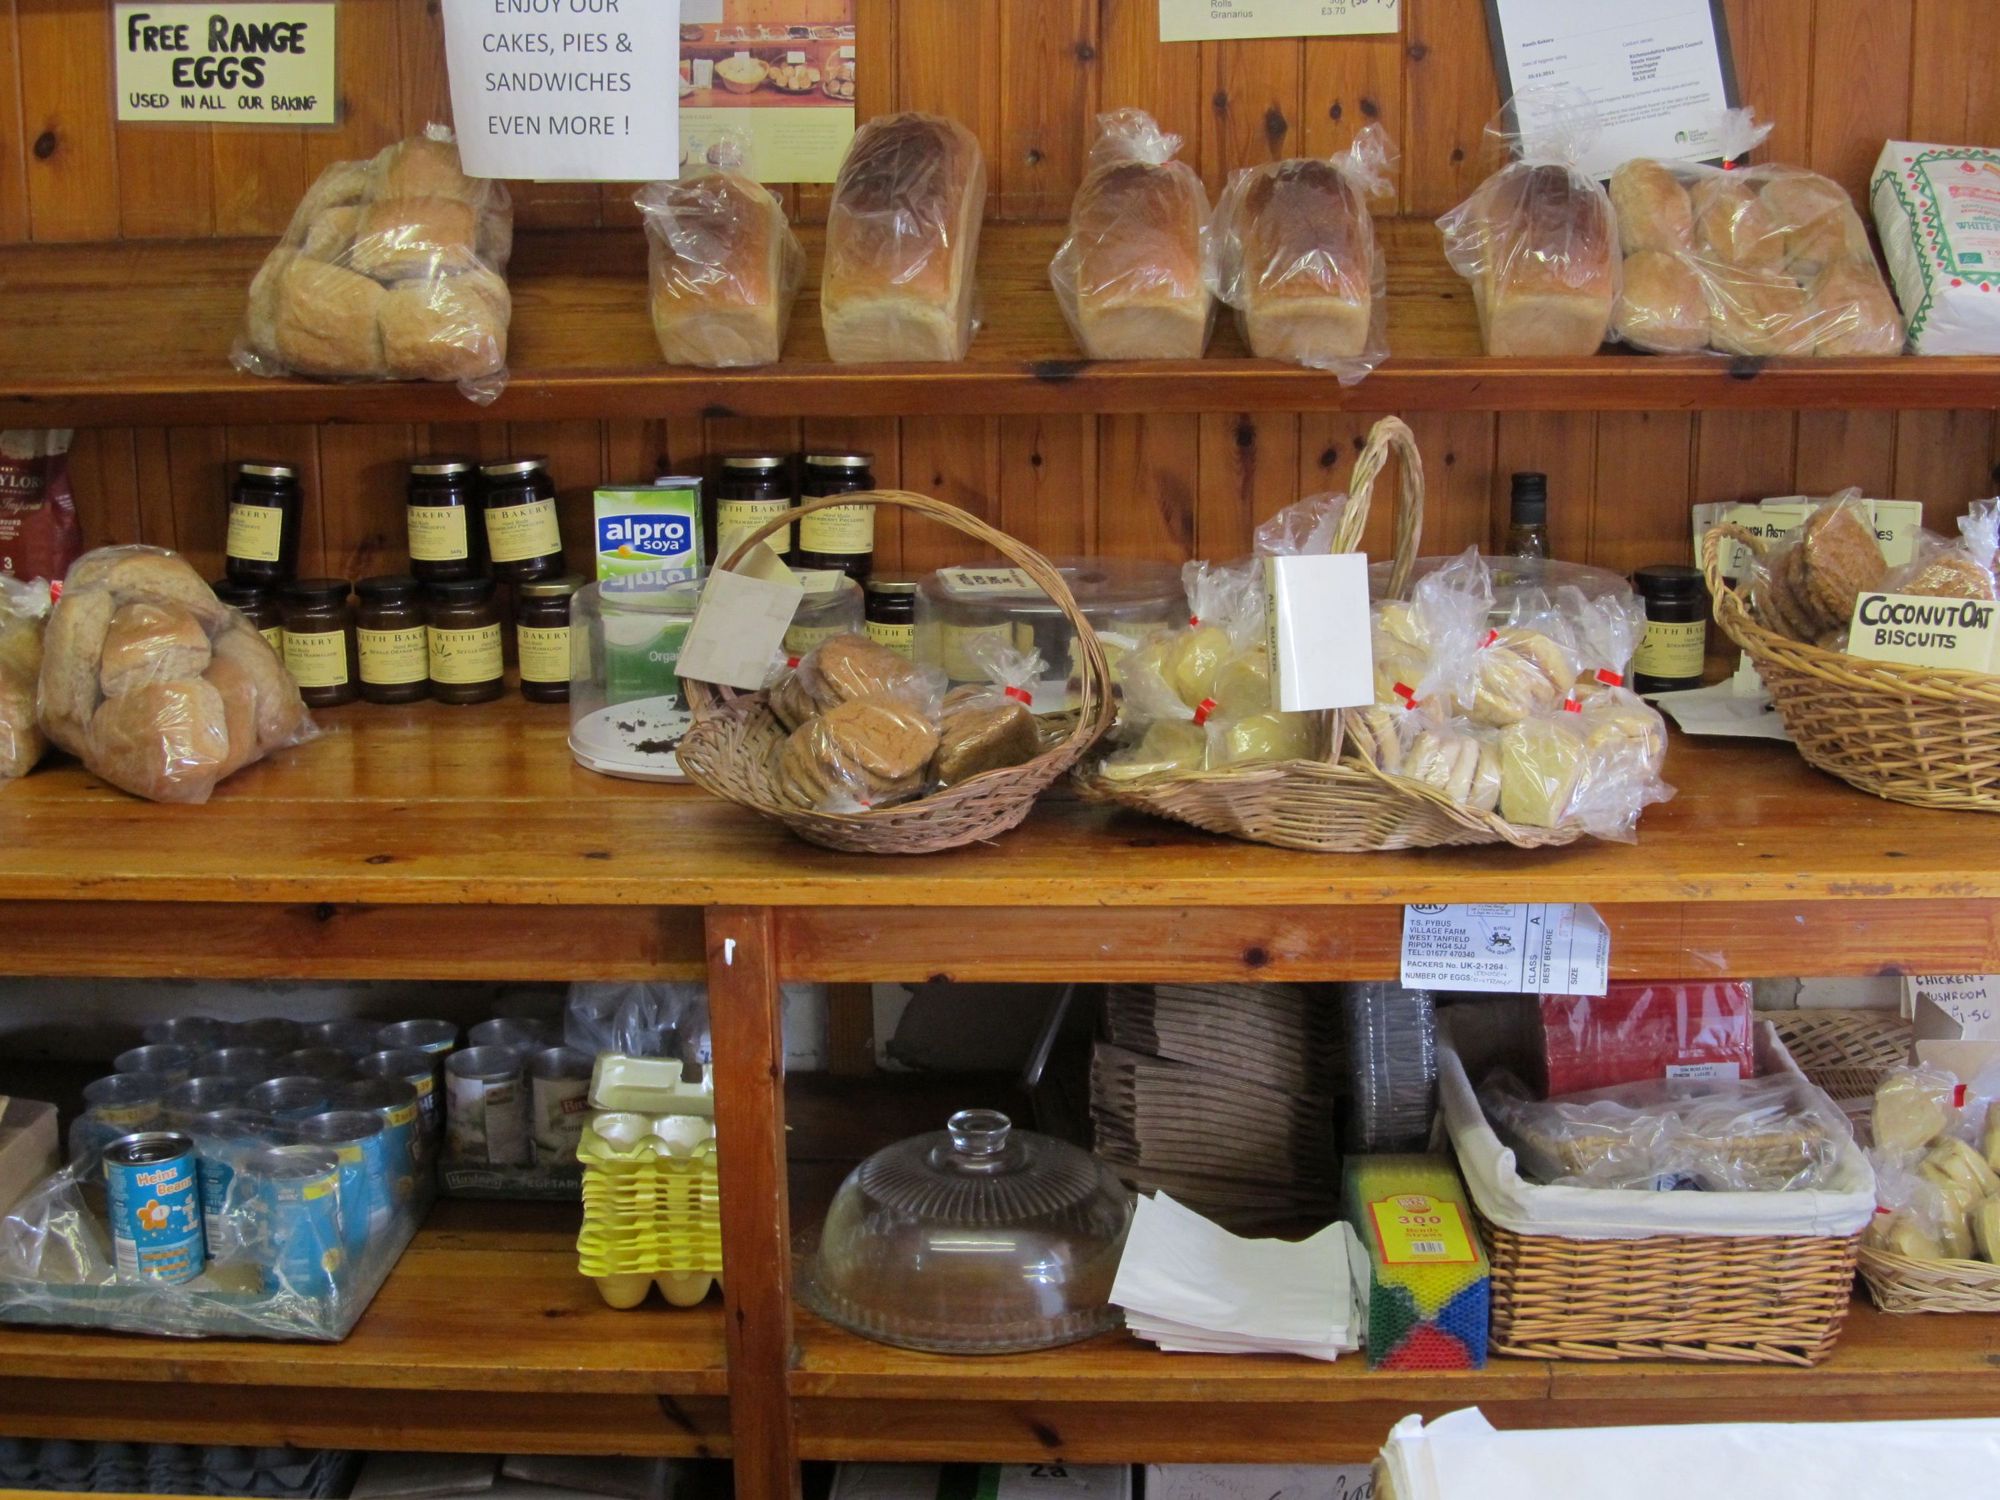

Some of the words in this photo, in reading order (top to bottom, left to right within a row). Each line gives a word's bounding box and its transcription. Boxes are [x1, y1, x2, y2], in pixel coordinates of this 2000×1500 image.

[495, 0, 560, 13] ENJOY
[570, 0, 619, 13] OUR
[482, 33, 554, 56] CAKES,
[563, 33, 608, 53] PIES
[615, 33, 633, 53] &
[172, 56, 266, 89] EGGS
[485, 72, 631, 92] SANDWICHES
[129, 92, 169, 109] USED
[181, 95, 195, 109] IN
[200, 95, 226, 109] ALL
[238, 96, 264, 110] OUR
[271, 95, 317, 111] BAKING
[488, 115, 541, 135] EVEN
[549, 116, 615, 135] MORE
[606, 518, 684, 546] alpro
[643, 540, 680, 552] soya
[4, 556, 13, 570] 3
[1859, 595, 1960, 628] COCONUT
[1959, 600, 1994, 630] OAT
[1874, 629, 1957, 649] BISCUITS
[1531, 916, 1541, 925] A
[1432, 935, 1471, 943] TANFIELD
[1545, 928, 1554, 961] BEFORE
[1407, 961, 1444, 969] PACKERS
[1528, 954, 1538, 985] CLASS
[1542, 963, 1550, 984] BEST
[1405, 972, 1437, 980] NUMBER
[1570, 967, 1579, 985] SIZE
[1915, 975, 1975, 986] CHICKEN
[137, 1167, 178, 1187] Heinz
[1398, 1216, 1442, 1224] 300
